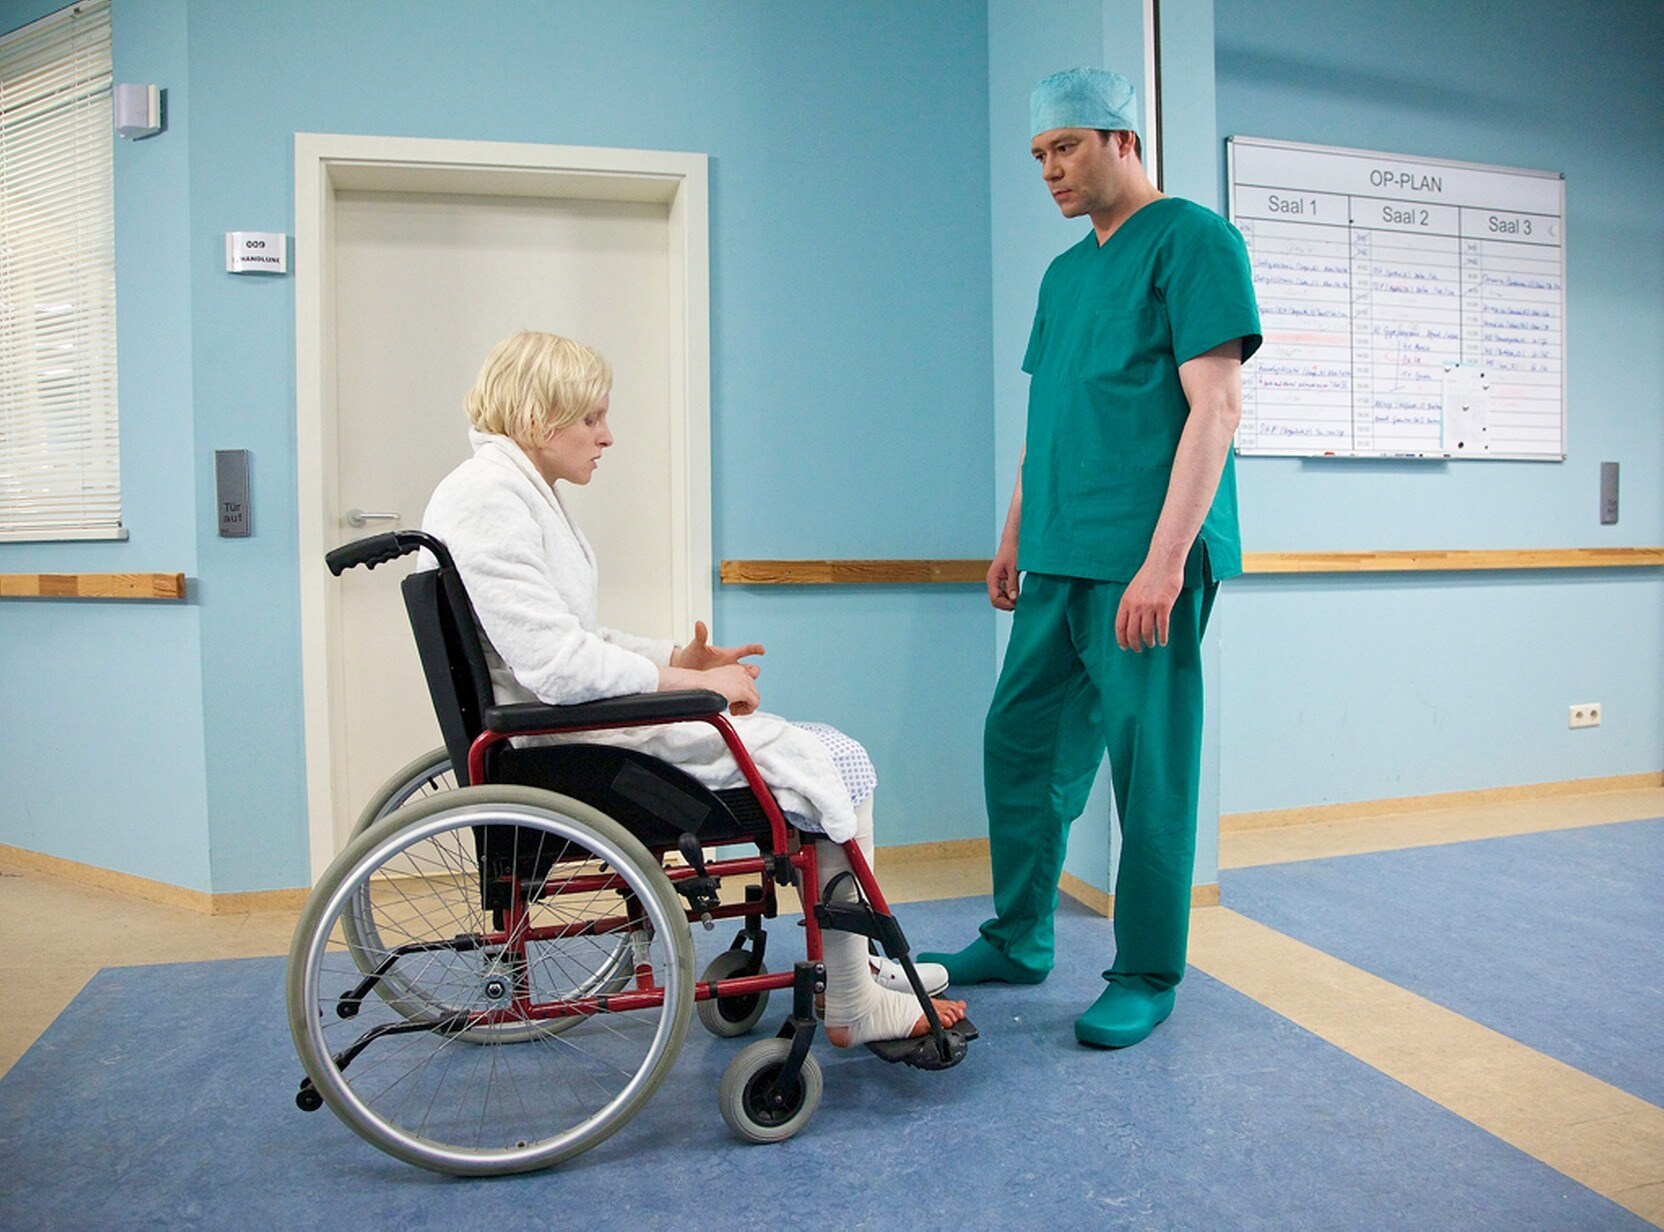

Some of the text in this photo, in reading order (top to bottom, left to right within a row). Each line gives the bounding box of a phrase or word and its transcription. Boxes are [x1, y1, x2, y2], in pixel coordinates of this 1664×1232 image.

[1370, 169, 1442, 193] OP-PLAN
[1268, 195, 1317, 215] Saal 1
[1382, 206, 1429, 226] Saal 2
[1488, 216, 1532, 235] Saal 3
[246, 240, 265, 248] 009
[223, 501, 241, 512] Tür
[223, 513, 242, 523] auf
